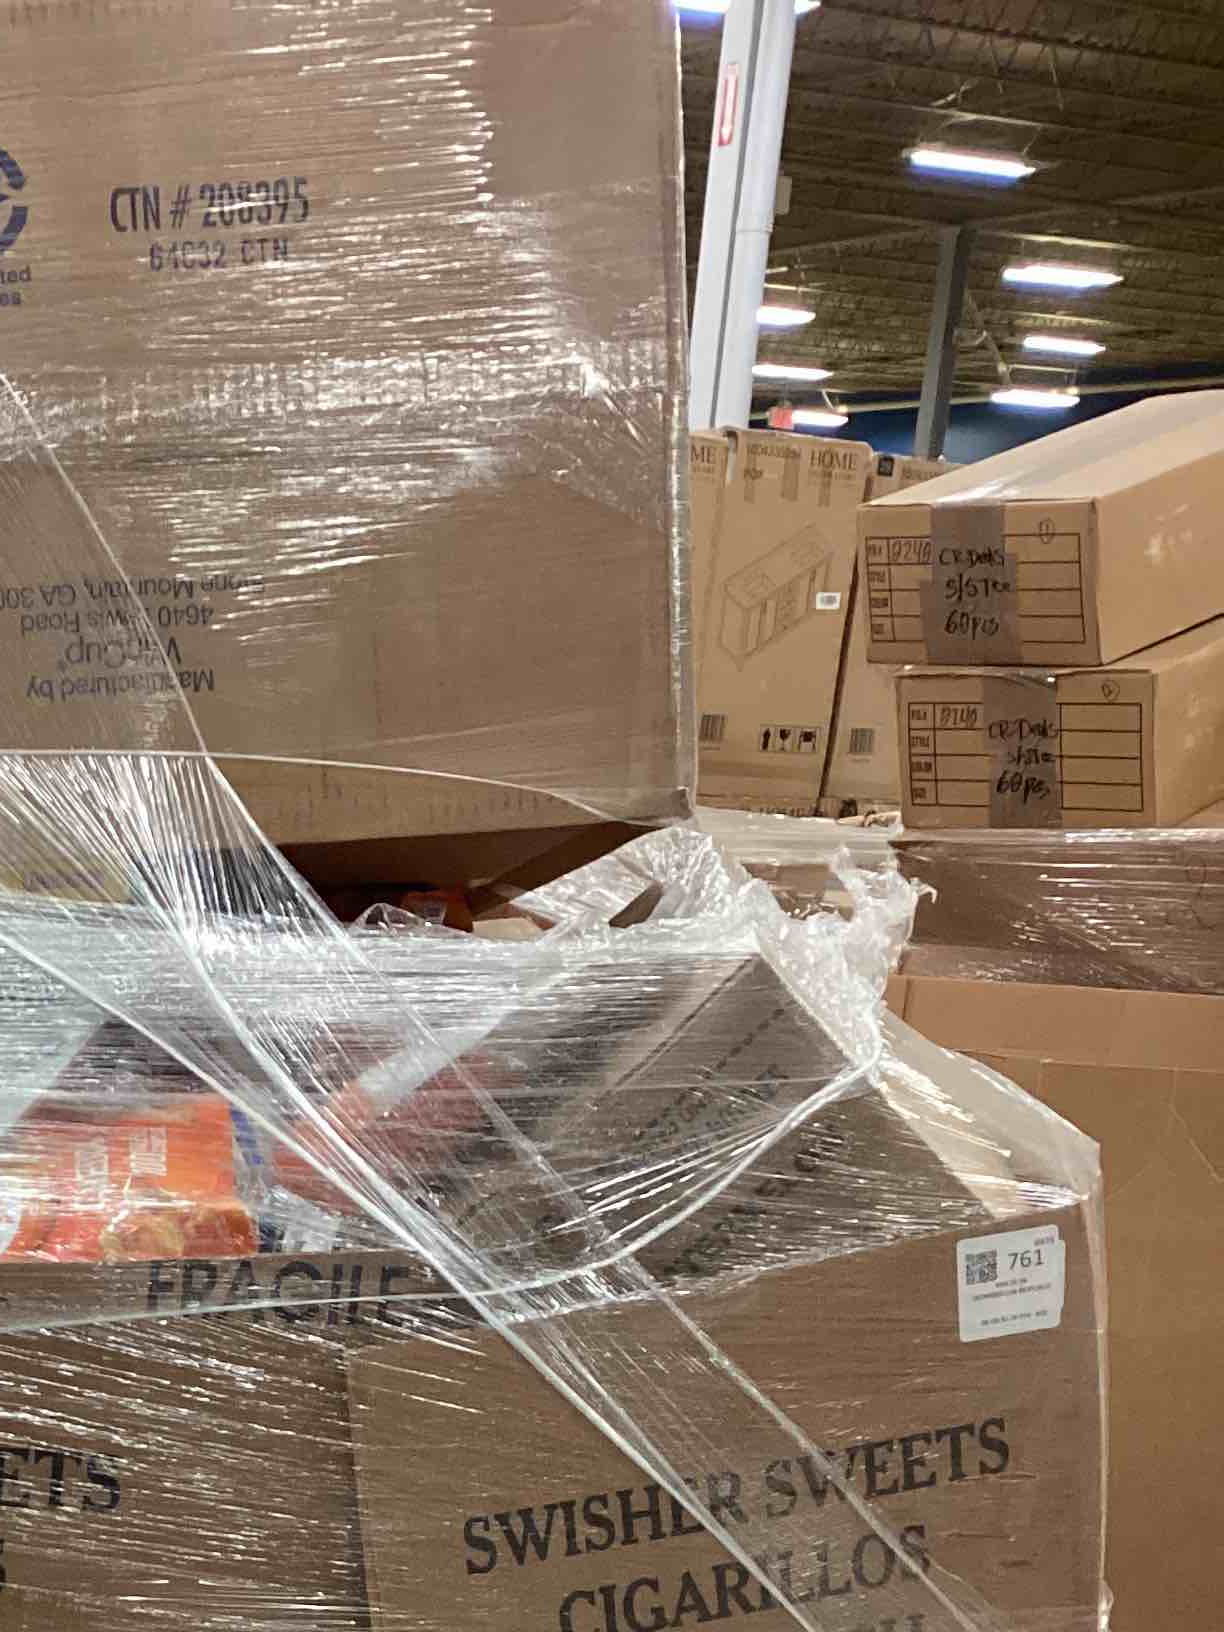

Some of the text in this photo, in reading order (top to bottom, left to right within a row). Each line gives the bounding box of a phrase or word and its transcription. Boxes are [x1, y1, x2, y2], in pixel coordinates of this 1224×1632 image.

[109, 175, 310, 233] CTN # 208395
[240, 238, 288, 265] CTN
[39, 584, 77, 606] GA
[21, 610, 81, 636] Road
[157, 603, 215, 626] 4640
[25, 675, 55, 705] by
[1007, 1248, 1045, 1271] 761
[146, 1257, 410, 1327] FRAGILE
[463, 1416, 1011, 1576] SWISHER SWEETS
